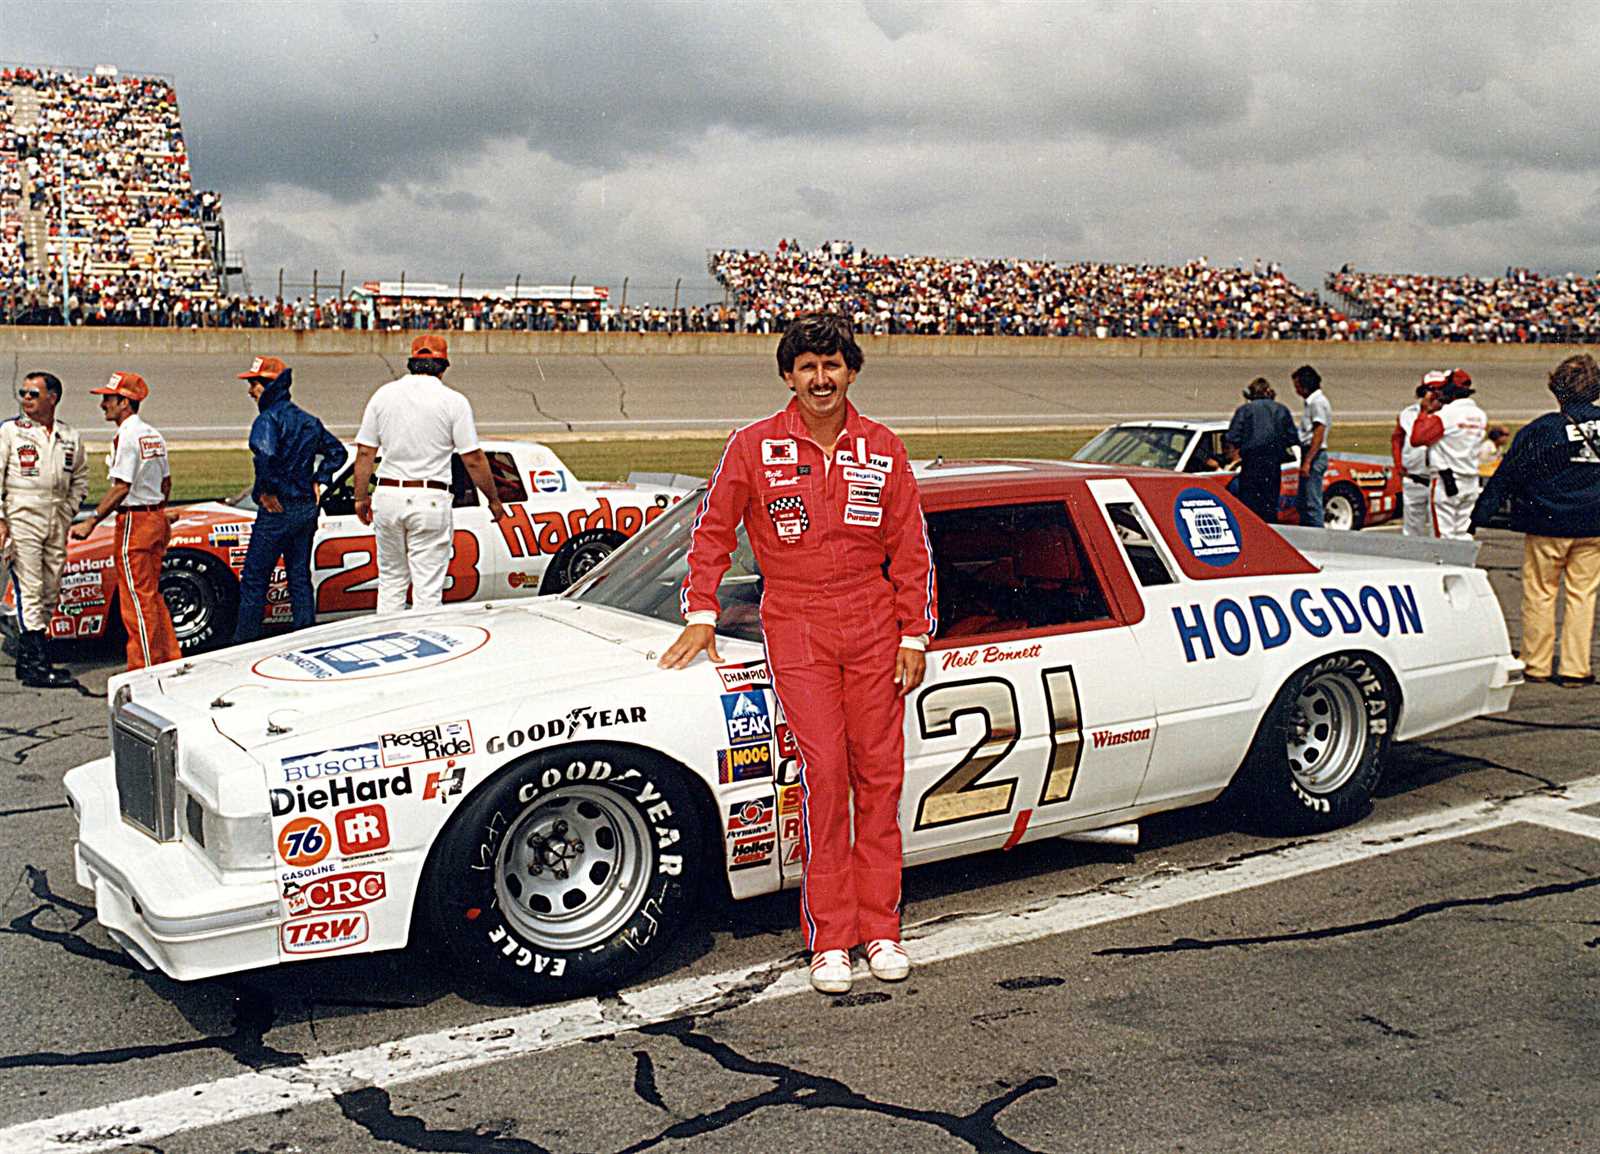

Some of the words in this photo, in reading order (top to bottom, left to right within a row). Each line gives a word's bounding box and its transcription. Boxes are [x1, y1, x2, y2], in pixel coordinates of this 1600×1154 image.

[63, 556, 115, 574] ieHard
[1171, 584, 1425, 663] HODGDON
[942, 651, 979, 671] Neil
[983, 644, 1042, 665] Bonnett
[724, 669, 766, 683] CHAMPIO
[381, 725, 442, 750] Regal
[728, 715, 770, 738] PEAK
[1091, 728, 1151, 749] Winston
[424, 737, 471, 760] Ride
[733, 746, 770, 767] MOOG
[913, 664, 1084, 832] 21
[285, 754, 381, 783] BUSCH
[271, 767, 413, 818] DieHard
[285, 825, 324, 857] 76
[732, 841, 775, 857] Holley
[282, 864, 336, 881] GASOLINE
[305, 874, 384, 909] CRC
[287, 916, 361, 944] TRW
[488, 925, 567, 977] EAGLE
